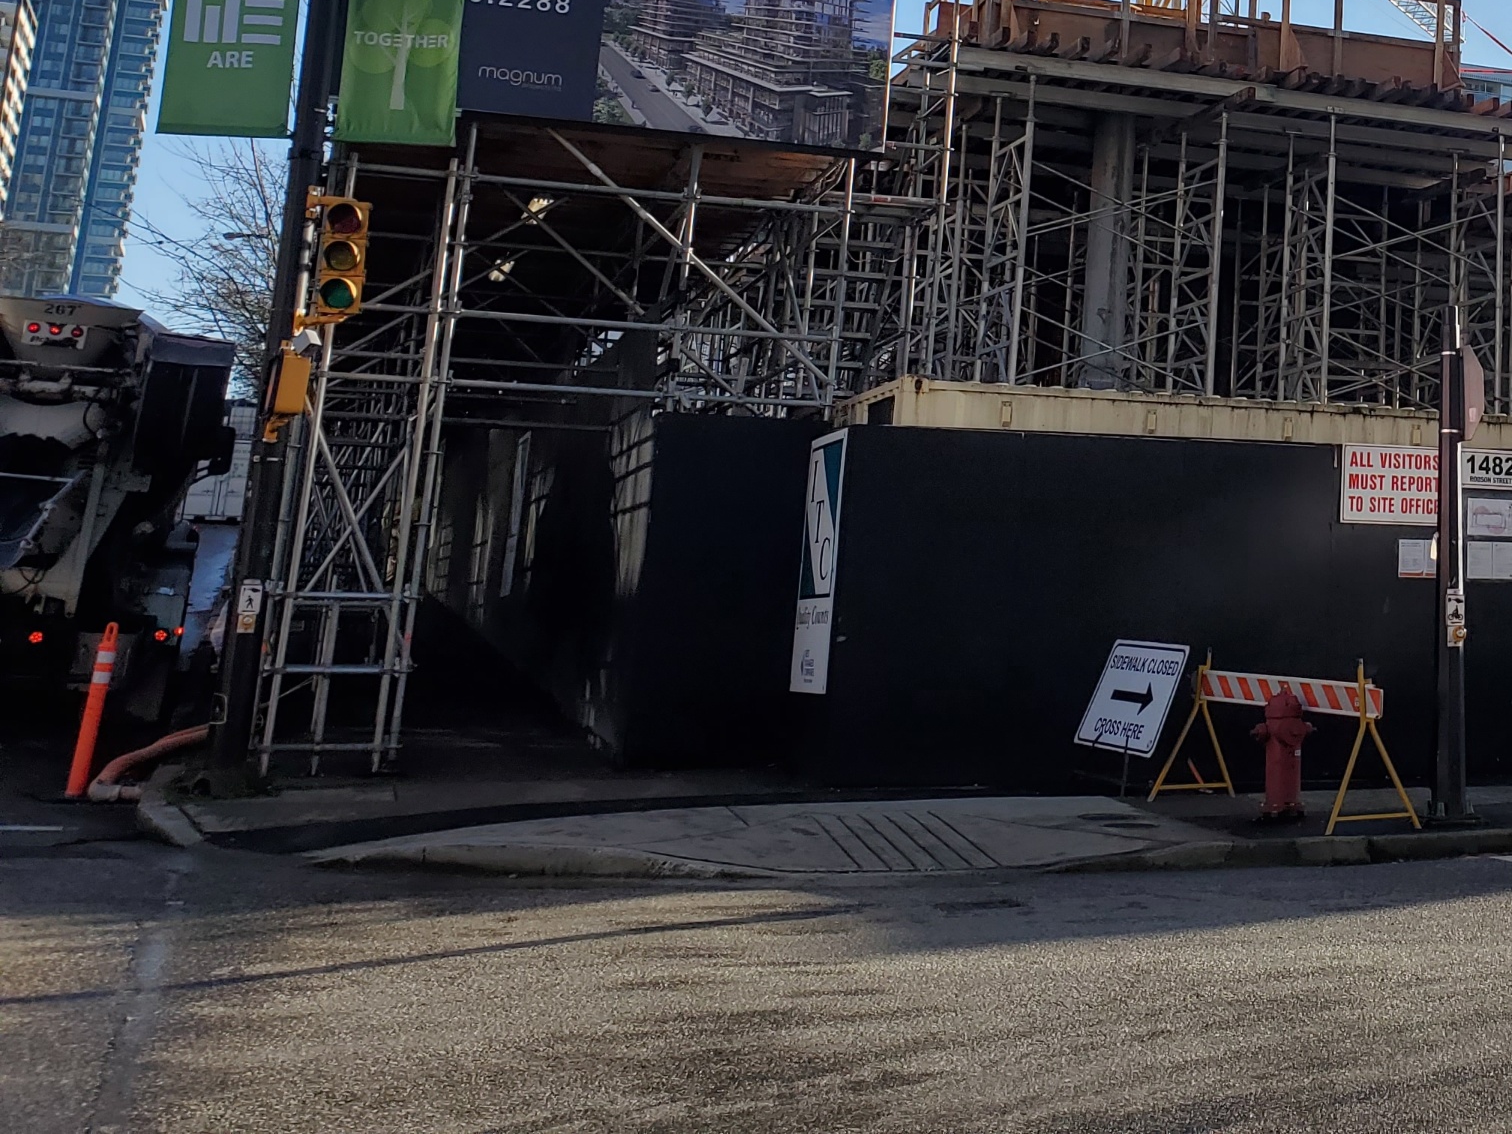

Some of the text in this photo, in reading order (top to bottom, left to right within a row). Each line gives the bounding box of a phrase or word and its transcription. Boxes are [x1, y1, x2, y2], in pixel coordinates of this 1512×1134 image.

[353, 31, 449, 48] TOGETHER
[206, 51, 254, 68] ARE
[478, 66, 562, 86] magnum
[1350, 451, 1439, 471] ALL VISITORS
[1348, 473, 1439, 493] MUST REPORT
[1492, 477, 1512, 485] STREET
[1348, 495, 1363, 513] TO
[1369, 497, 1395, 514] SITE
[810, 460, 831, 581] ITC
[1110, 654, 1180, 676] SIDEWALK CLOSED
[1094, 717, 1145, 740] CROSS HERE
